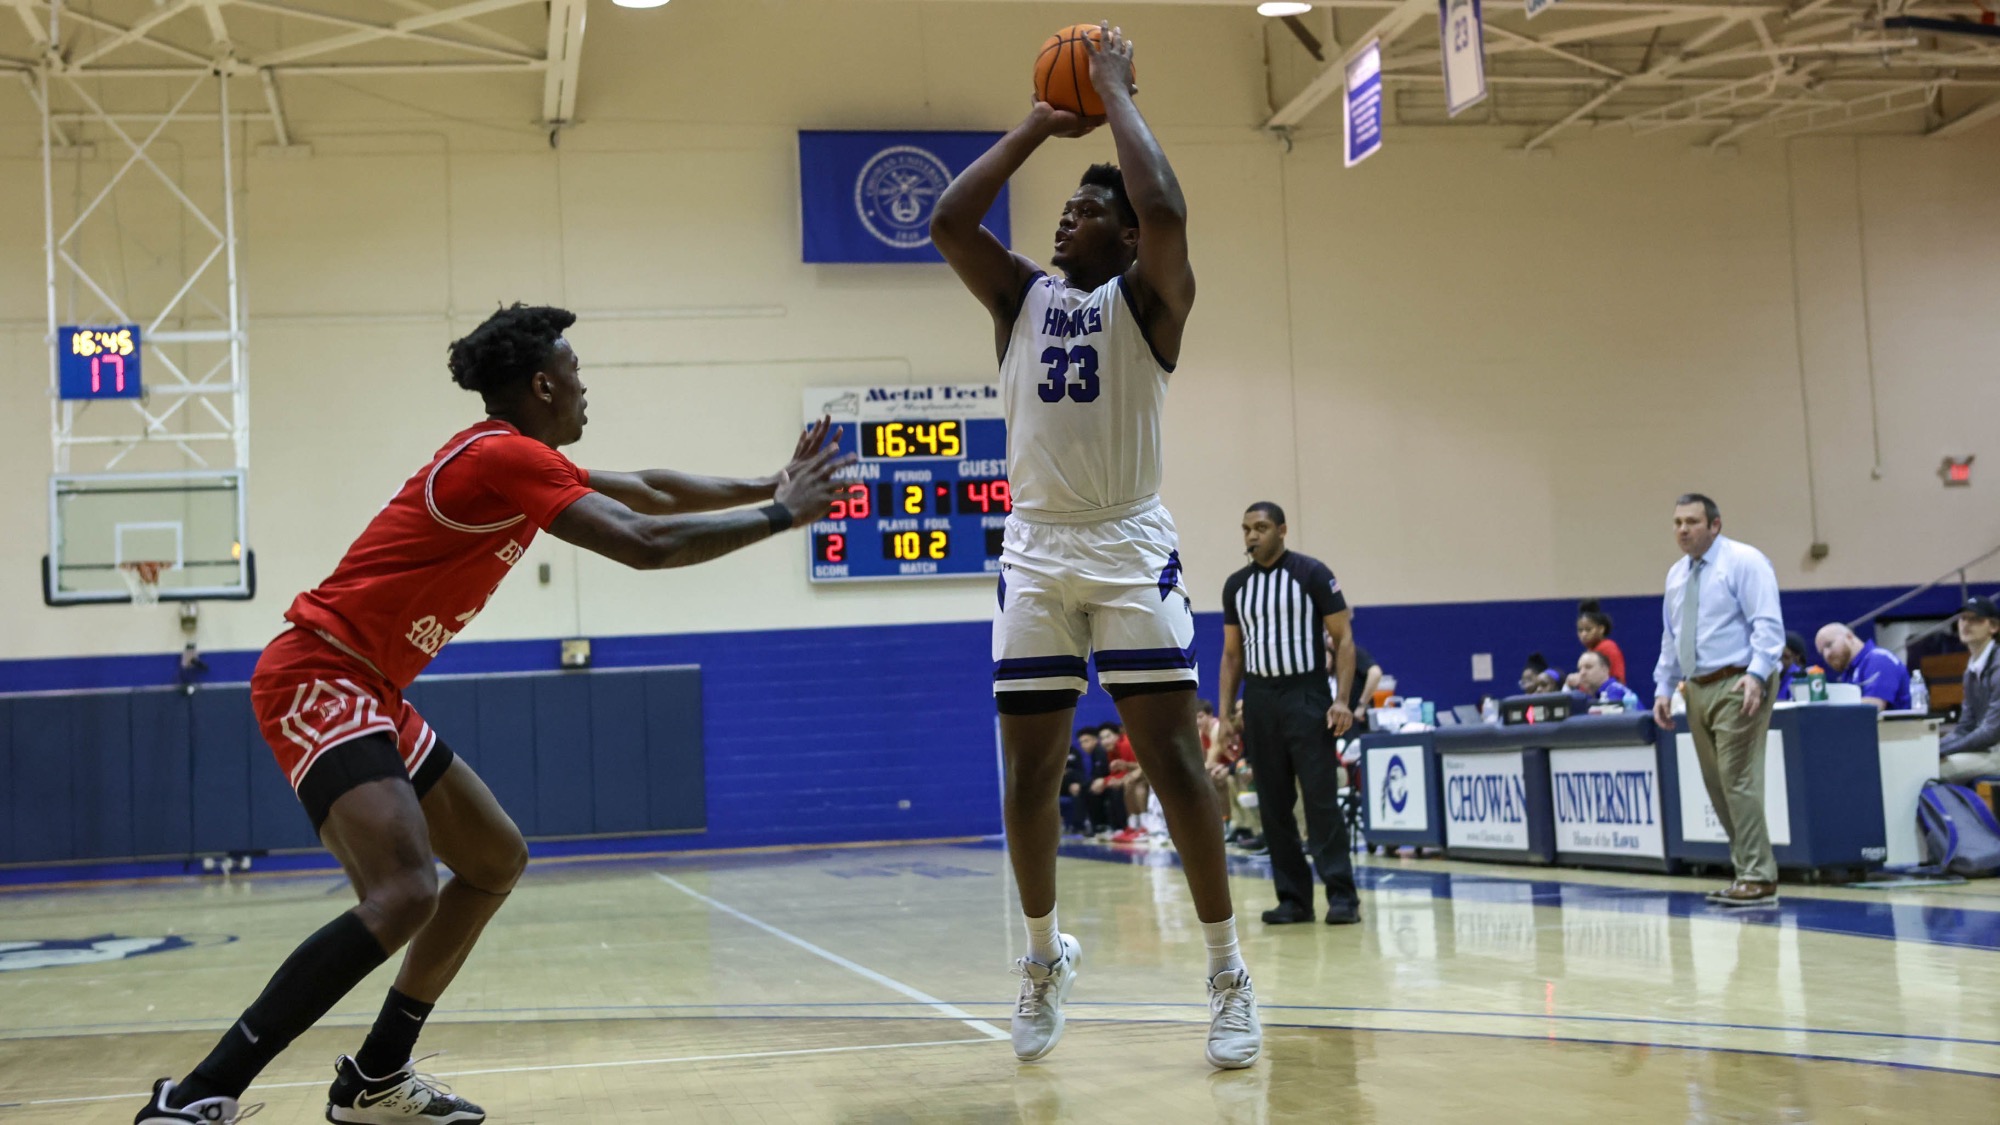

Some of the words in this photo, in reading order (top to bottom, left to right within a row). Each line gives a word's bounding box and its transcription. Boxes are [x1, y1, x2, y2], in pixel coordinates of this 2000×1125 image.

[72, 329, 134, 357] 16:45
[91, 354, 124, 393] 17
[1038, 345, 1100, 403] 33
[866, 387, 933, 402] Metal
[939, 386, 998, 399] Tech
[876, 421, 960, 458] 16:45
[893, 470, 933, 483] PERIOD
[904, 485, 923, 515] 2
[967, 480, 1011, 513] 49
[813, 521, 848, 533] FOULS
[877, 518, 919, 531] PLAYER
[923, 517, 952, 530] FOUL
[825, 533, 844, 563] 2
[893, 531, 920, 560] 10
[928, 530, 947, 560] 2
[815, 564, 849, 577] SCORE
[899, 561, 937, 574] MATCH
[1447, 773, 1527, 823] CHOWAN
[1554, 770, 1654, 825] UNIVERSITY
